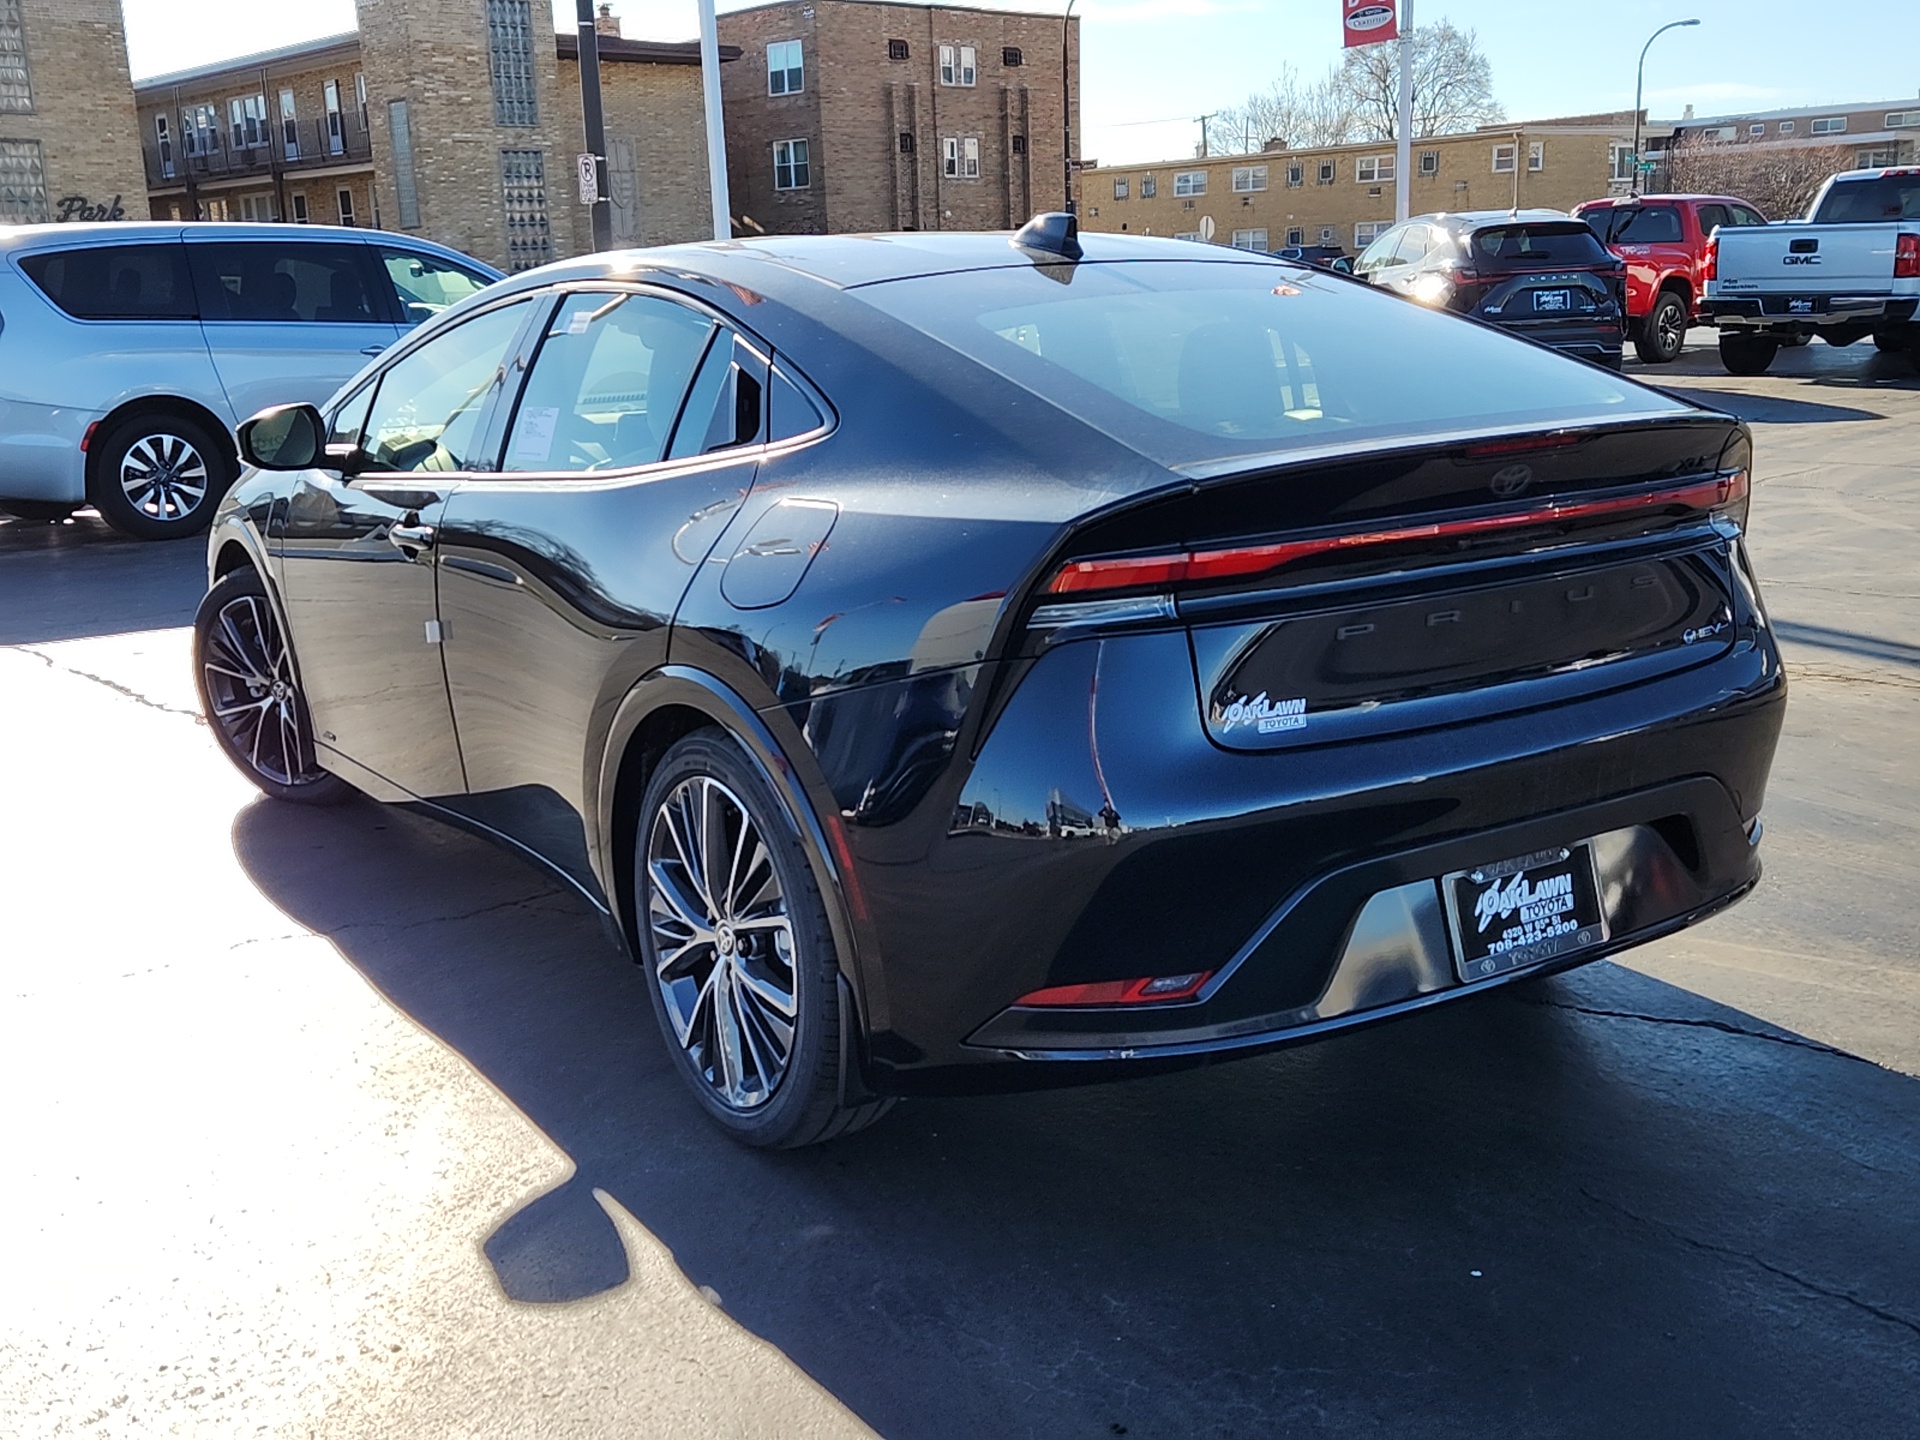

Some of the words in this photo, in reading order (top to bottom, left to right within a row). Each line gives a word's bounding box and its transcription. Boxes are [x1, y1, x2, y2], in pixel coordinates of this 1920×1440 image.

[56, 194, 125, 223] Park
[1782, 255, 1822, 265] GMC
[1336, 575, 1658, 641] PRIUS
[1264, 716, 1300, 728] TOYOTA
[1526, 896, 1569, 918] TOYOTA
[1502, 926, 1524, 939] 4320
